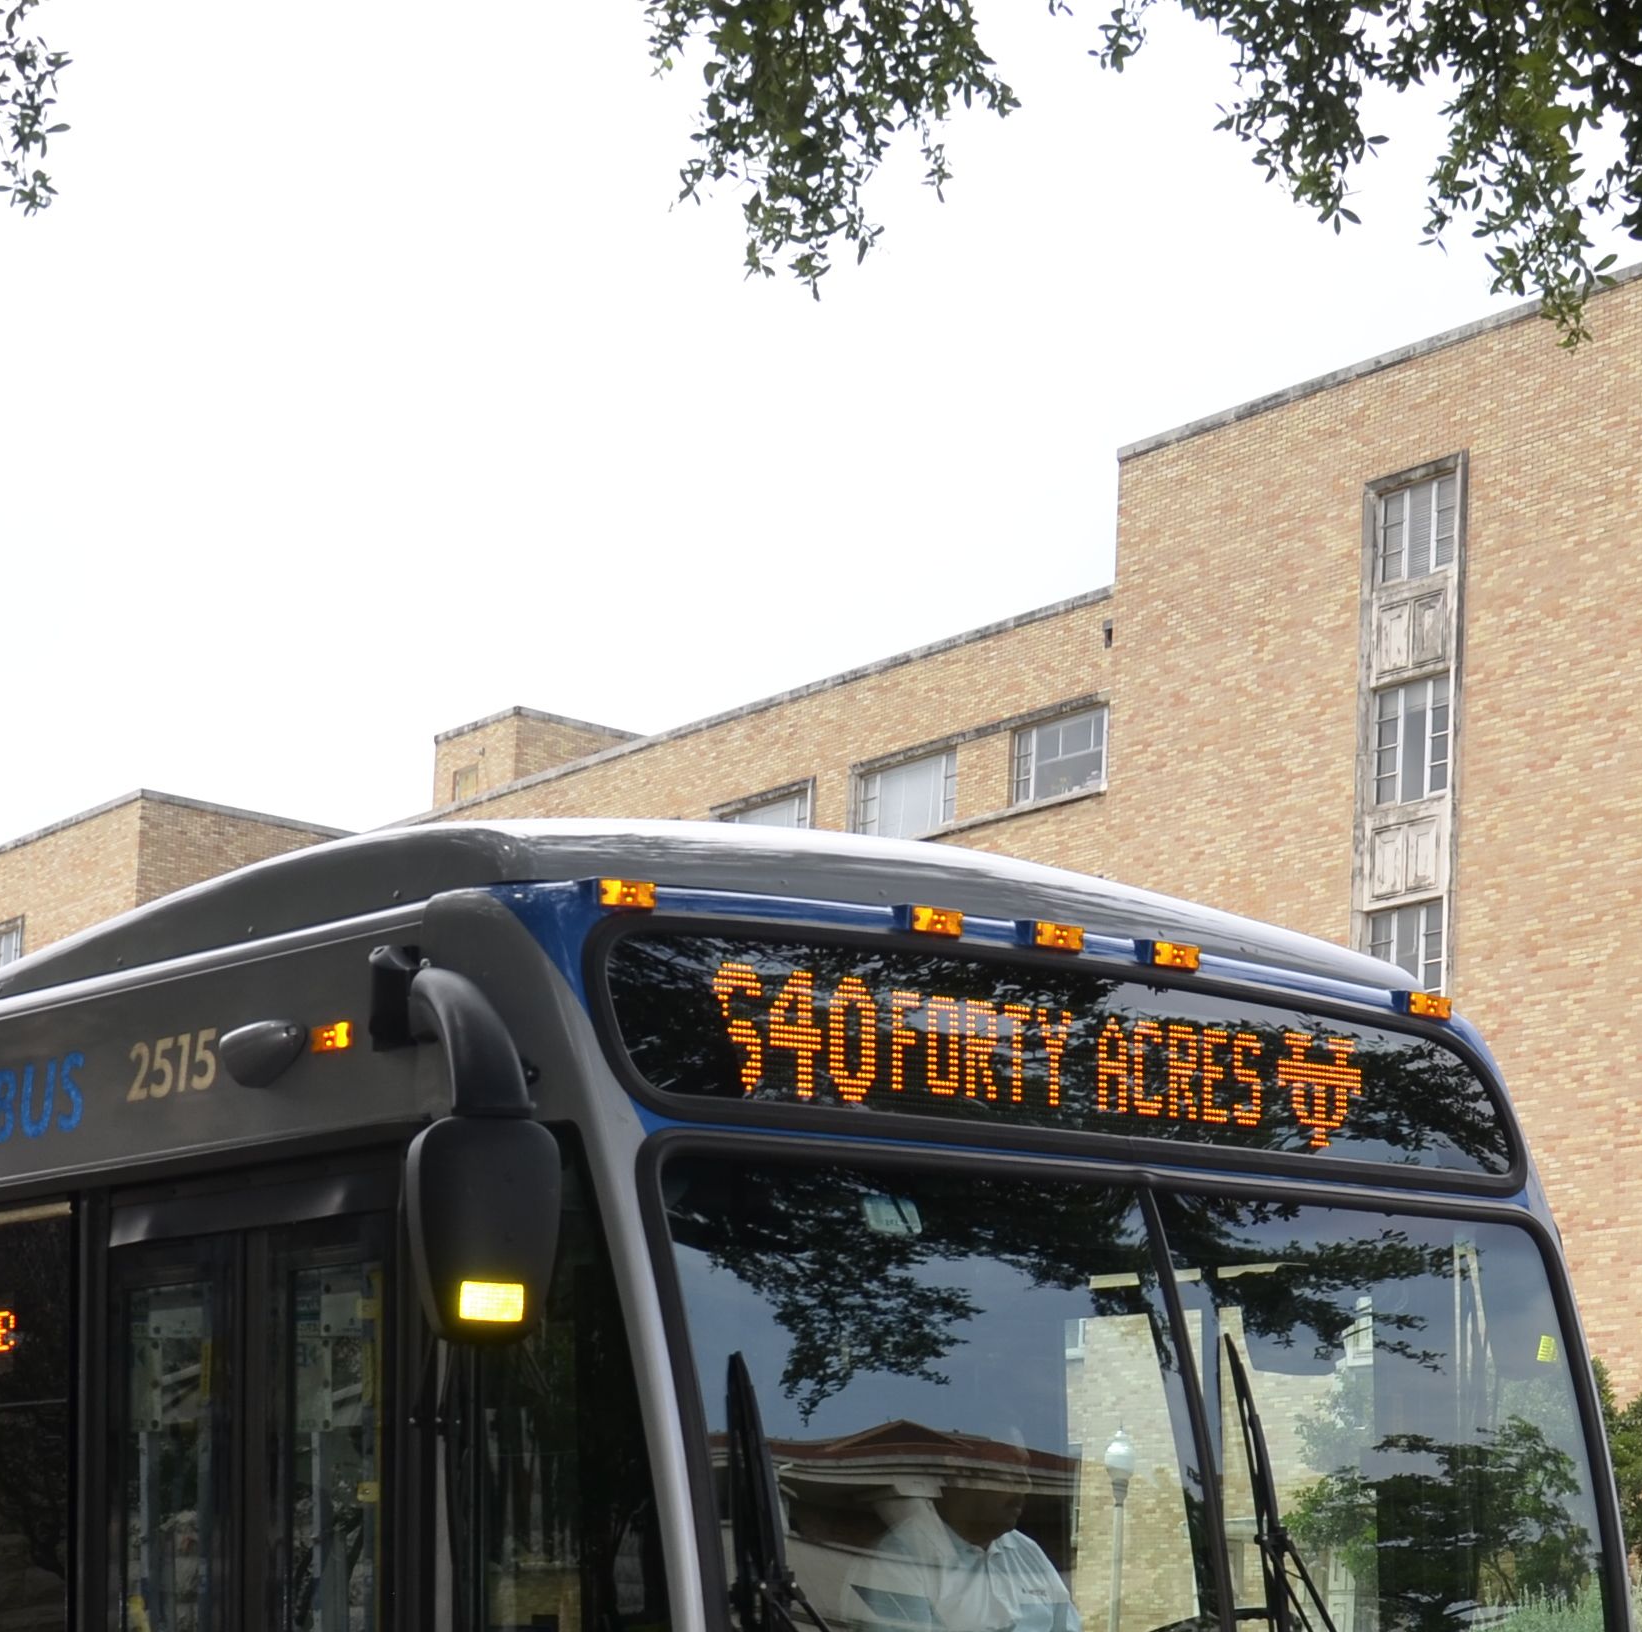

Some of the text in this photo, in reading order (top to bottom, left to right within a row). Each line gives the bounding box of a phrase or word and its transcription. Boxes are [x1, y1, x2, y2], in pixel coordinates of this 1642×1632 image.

[126, 1026, 218, 1102] 2515
[891, 988, 1073, 1106] FORTY
[1097, 1015, 1262, 1127] ACRES
